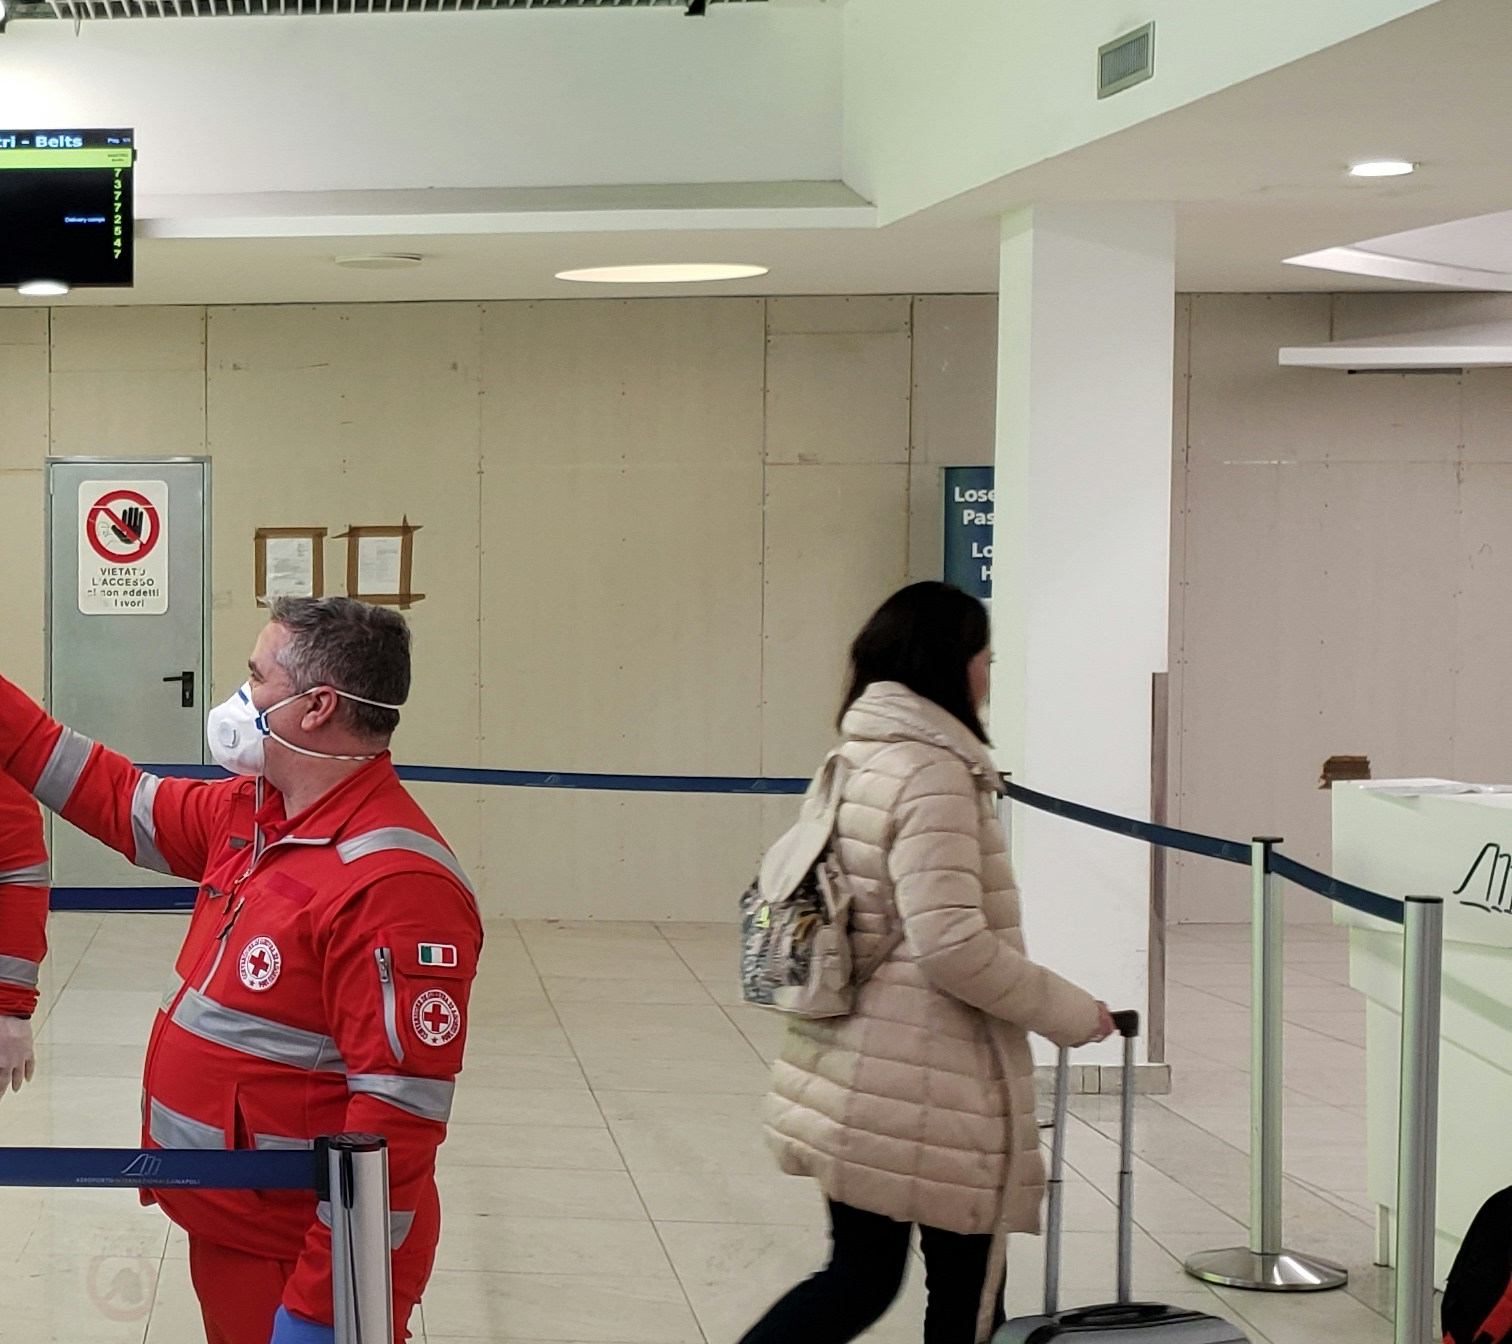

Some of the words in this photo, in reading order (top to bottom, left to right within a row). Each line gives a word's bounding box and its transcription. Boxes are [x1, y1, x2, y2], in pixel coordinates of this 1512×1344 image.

[35, 136, 84, 148] Belts
[113, 168, 122, 177] 7
[113, 179, 122, 189] 3
[113, 191, 122, 201] 7
[113, 202, 122, 212] 7
[113, 214, 122, 225] 2
[113, 238, 122, 248] 4
[113, 249, 122, 259] 7
